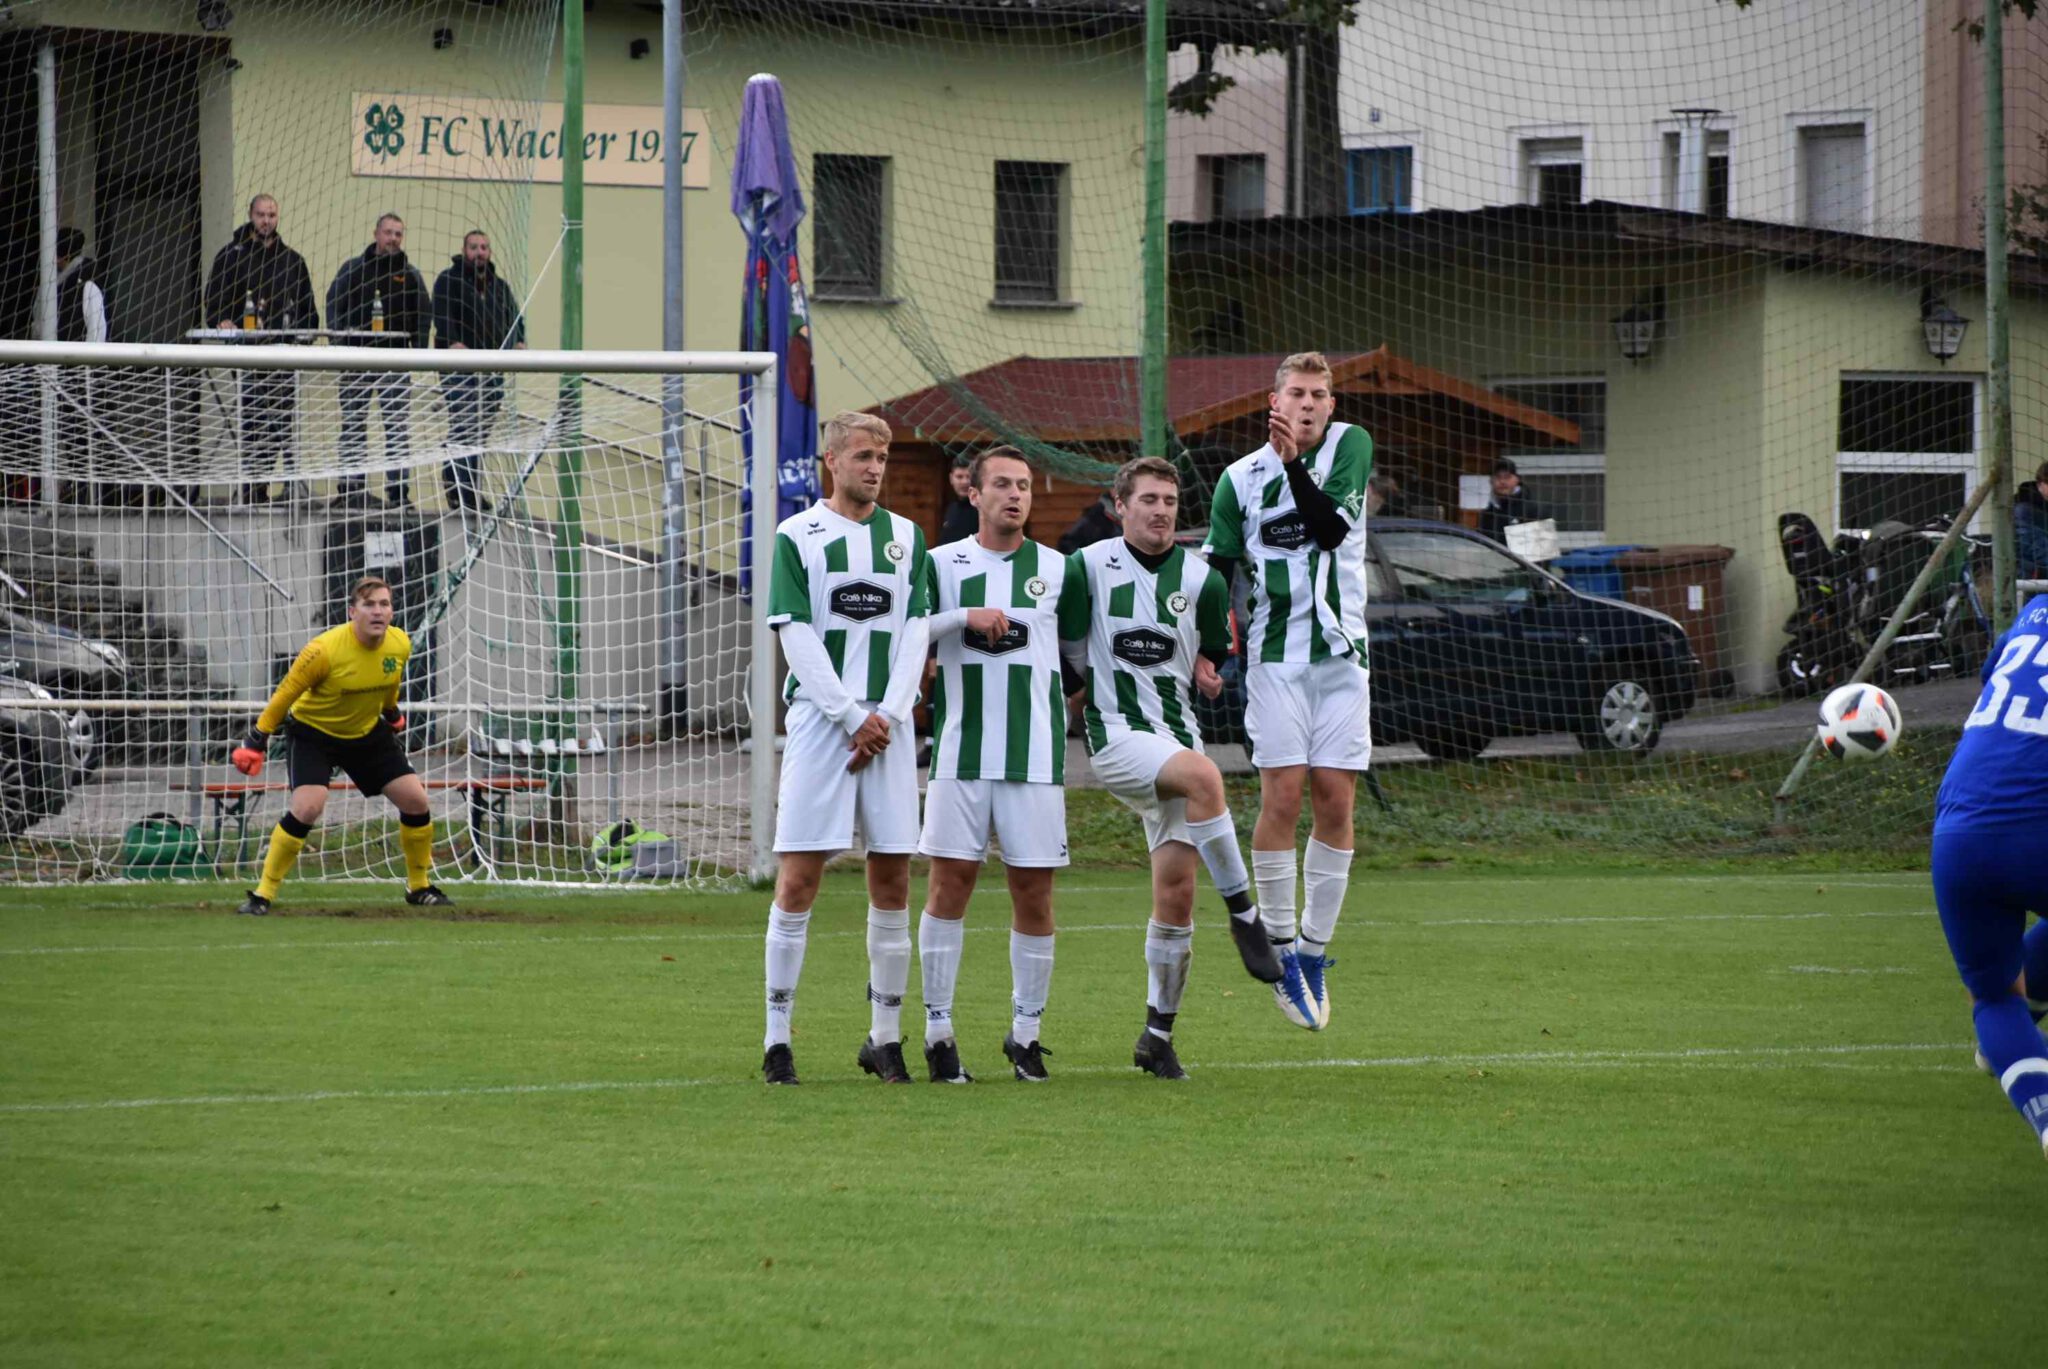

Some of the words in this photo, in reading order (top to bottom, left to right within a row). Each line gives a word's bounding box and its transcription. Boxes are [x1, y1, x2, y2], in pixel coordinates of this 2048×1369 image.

[418, 114, 468, 156] FC
[479, 117, 617, 161] Wacer
[624, 129, 698, 165] 197
[862, 594, 883, 603] Nika
[2027, 607, 2047, 624] FC
